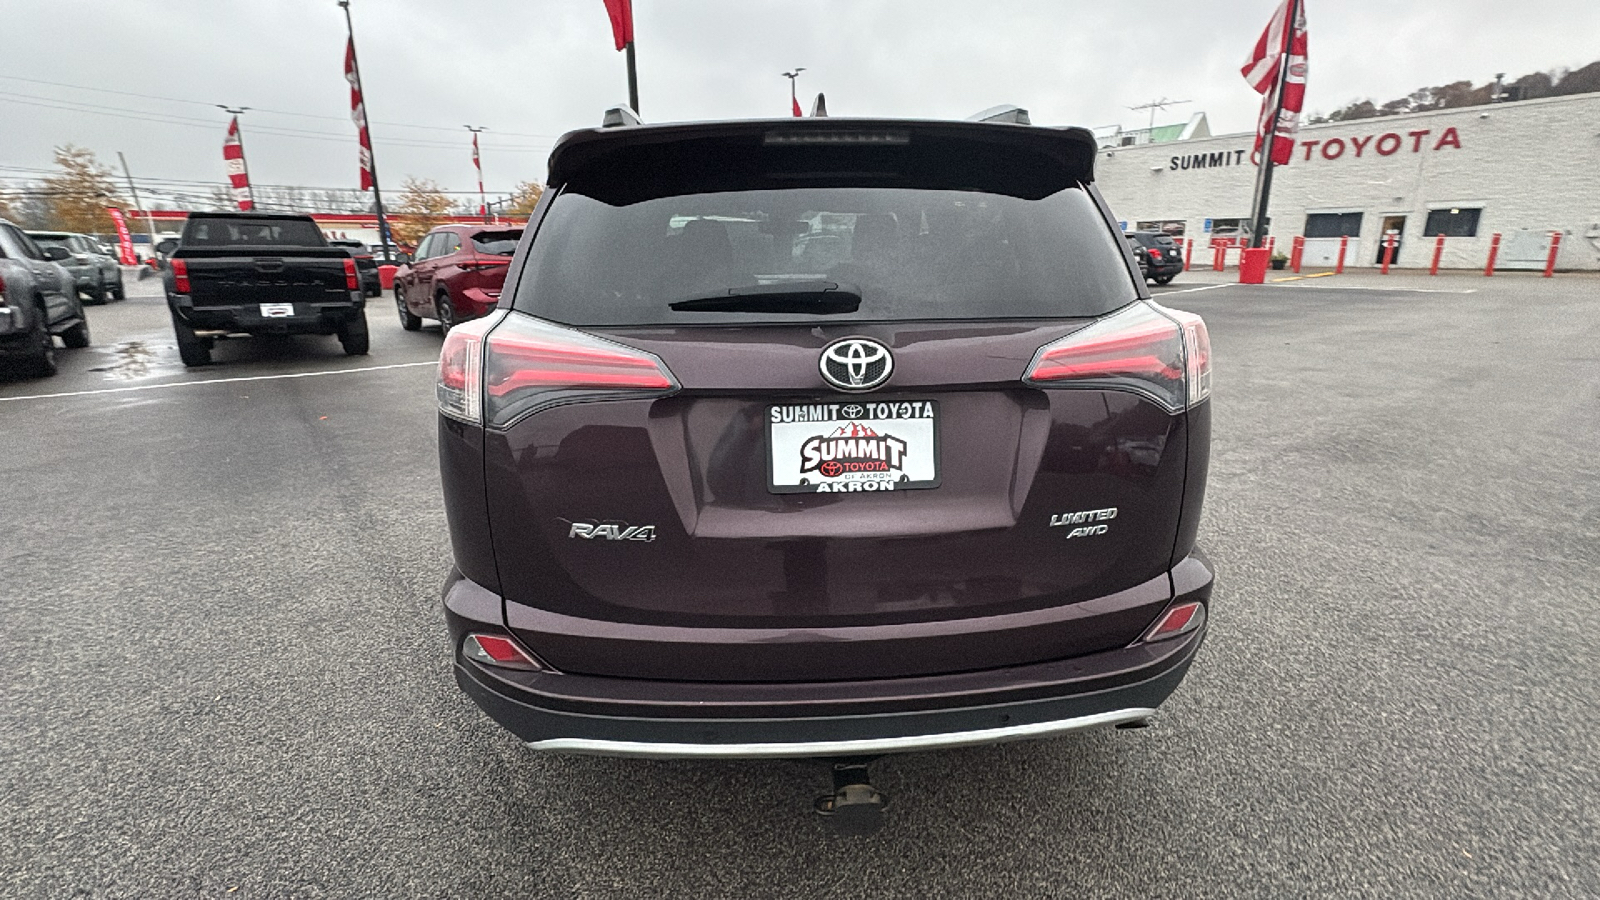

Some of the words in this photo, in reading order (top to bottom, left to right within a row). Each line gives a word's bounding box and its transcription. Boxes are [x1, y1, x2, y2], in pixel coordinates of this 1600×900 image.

[1169, 150, 1245, 170] SUMMIT
[1301, 127, 1461, 161] TOYOTA
[771, 404, 839, 423] SUMMIT
[867, 402, 934, 419] TOYOTA
[802, 435, 906, 472] SUMMIT
[843, 461, 889, 472] TOYOTA
[817, 481, 894, 493] AKRON
[1049, 507, 1118, 527] LIMITED
[568, 523, 656, 542] RAV4
[1066, 525, 1108, 539] AWD
